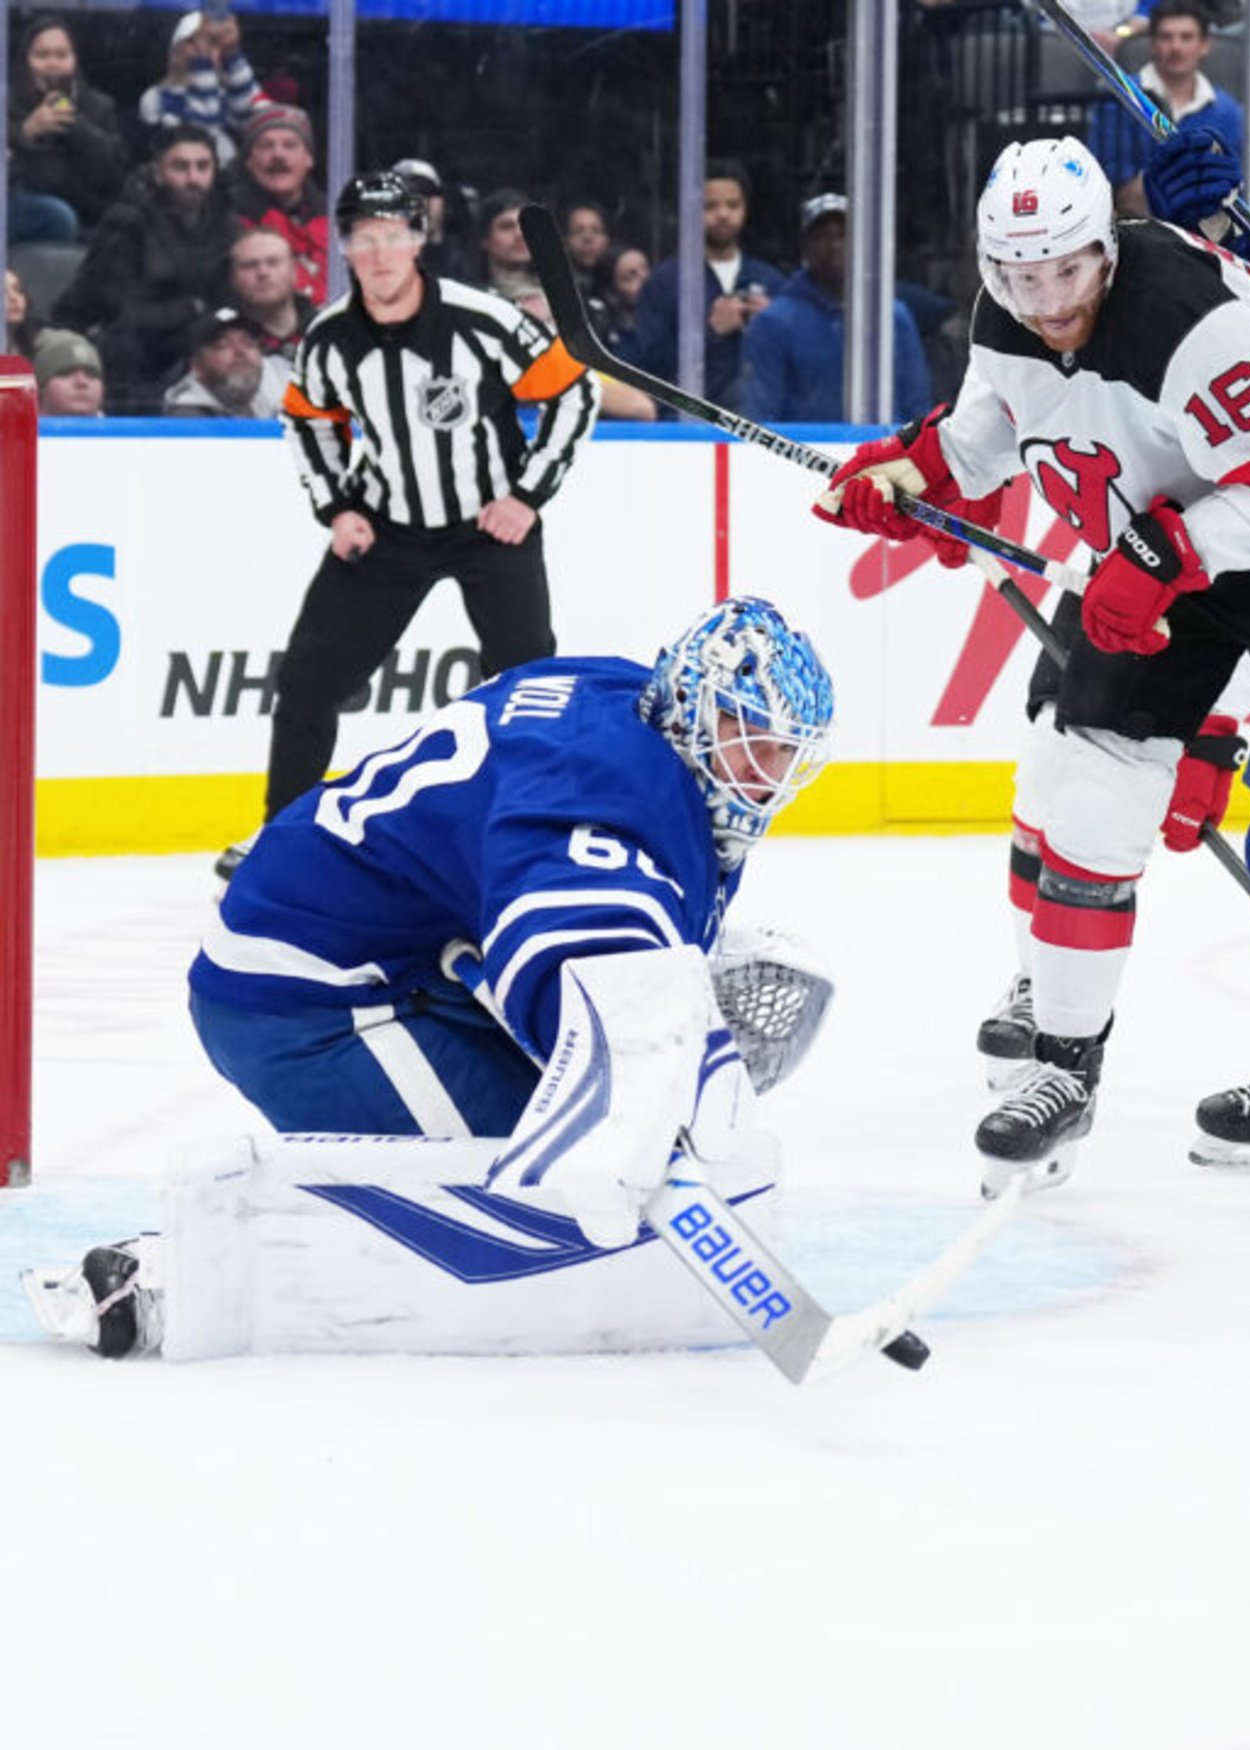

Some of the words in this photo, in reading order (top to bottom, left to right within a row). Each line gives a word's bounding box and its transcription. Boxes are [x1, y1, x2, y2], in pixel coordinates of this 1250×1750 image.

[1012, 189, 1039, 216] 16
[41, 543, 121, 688] S
[159, 650, 285, 717] NH
[498, 675, 579, 726] WOLL
[669, 1202, 792, 1330] BAUER
